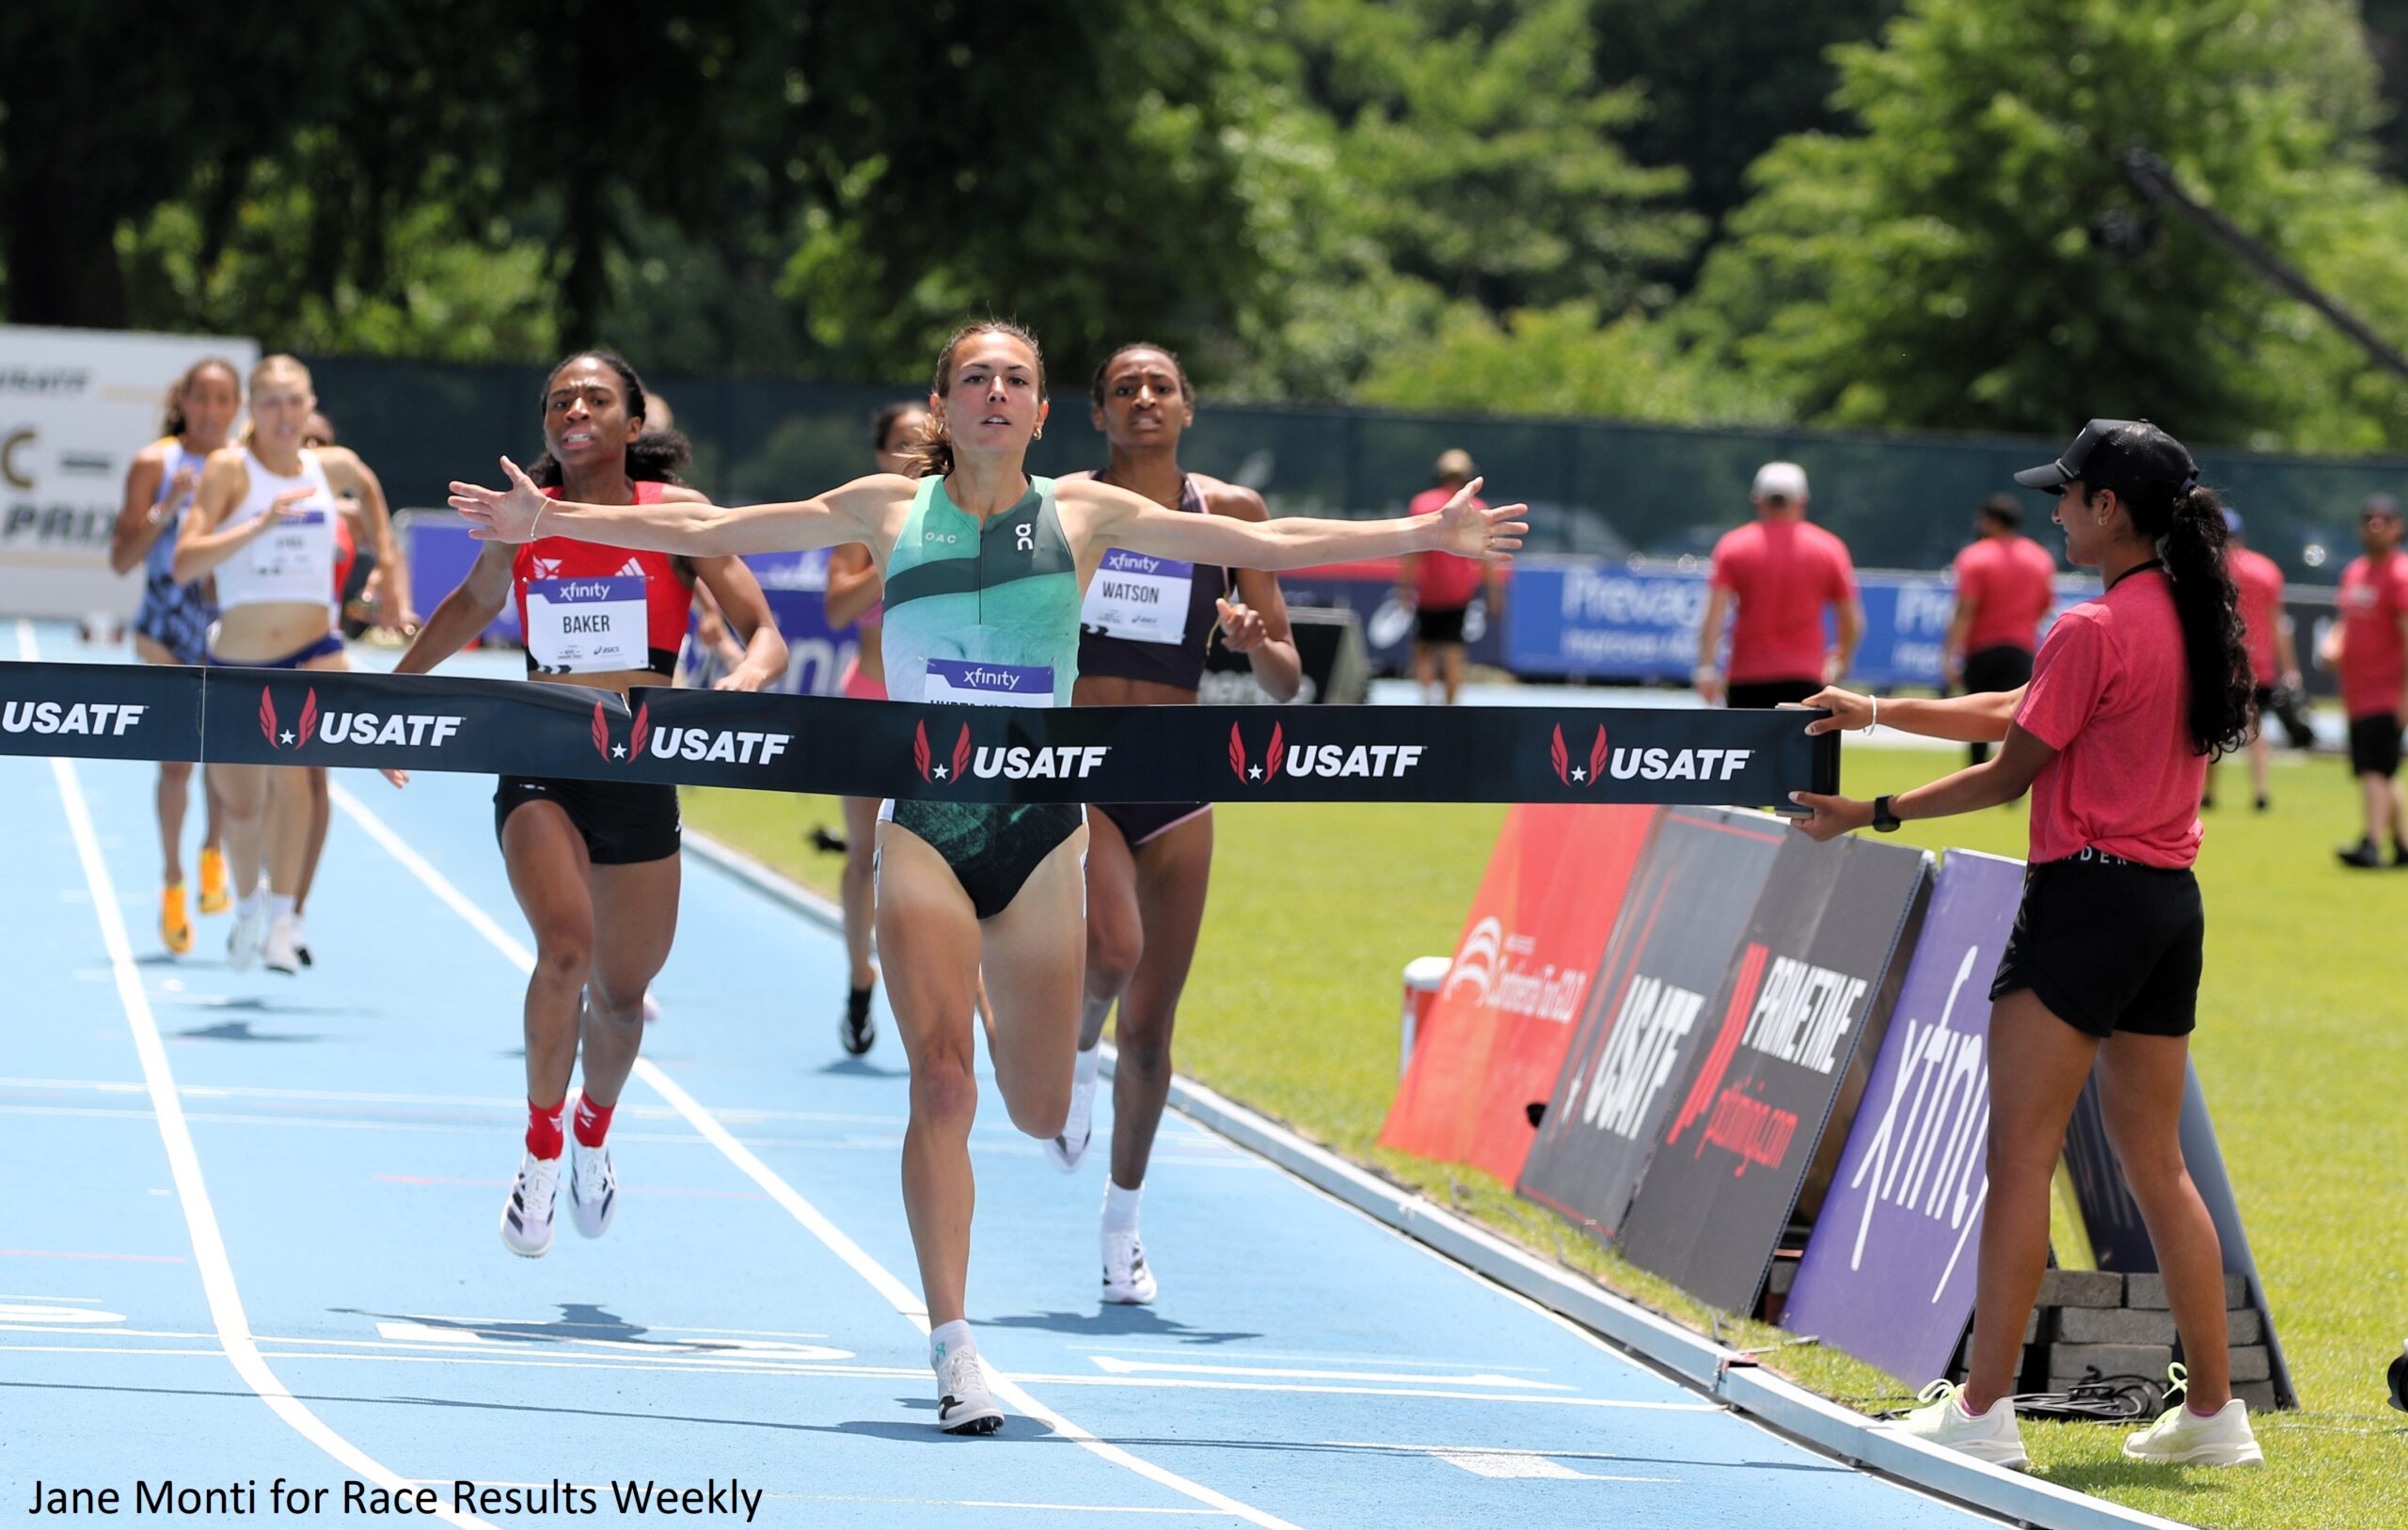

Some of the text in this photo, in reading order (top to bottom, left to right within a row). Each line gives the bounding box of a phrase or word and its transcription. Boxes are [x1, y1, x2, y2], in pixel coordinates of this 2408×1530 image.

[926, 532, 956, 544] OAC
[1109, 553, 1159, 574] xfinity
[560, 582, 610, 602] xfinity
[1102, 581, 1159, 604] WATSON
[562, 615, 610, 634] BAKER
[963, 667, 1021, 690] xfinity
[2, 701, 145, 735] USATF
[319, 711, 463, 747] USATF
[650, 726, 790, 765] USATF
[1286, 744, 1422, 778] USATF
[973, 746, 1109, 780] USATF
[1609, 748, 1750, 781] USATF
[1741, 955, 1868, 1075] PRIMETIME
[1583, 974, 1706, 1141] USATF
